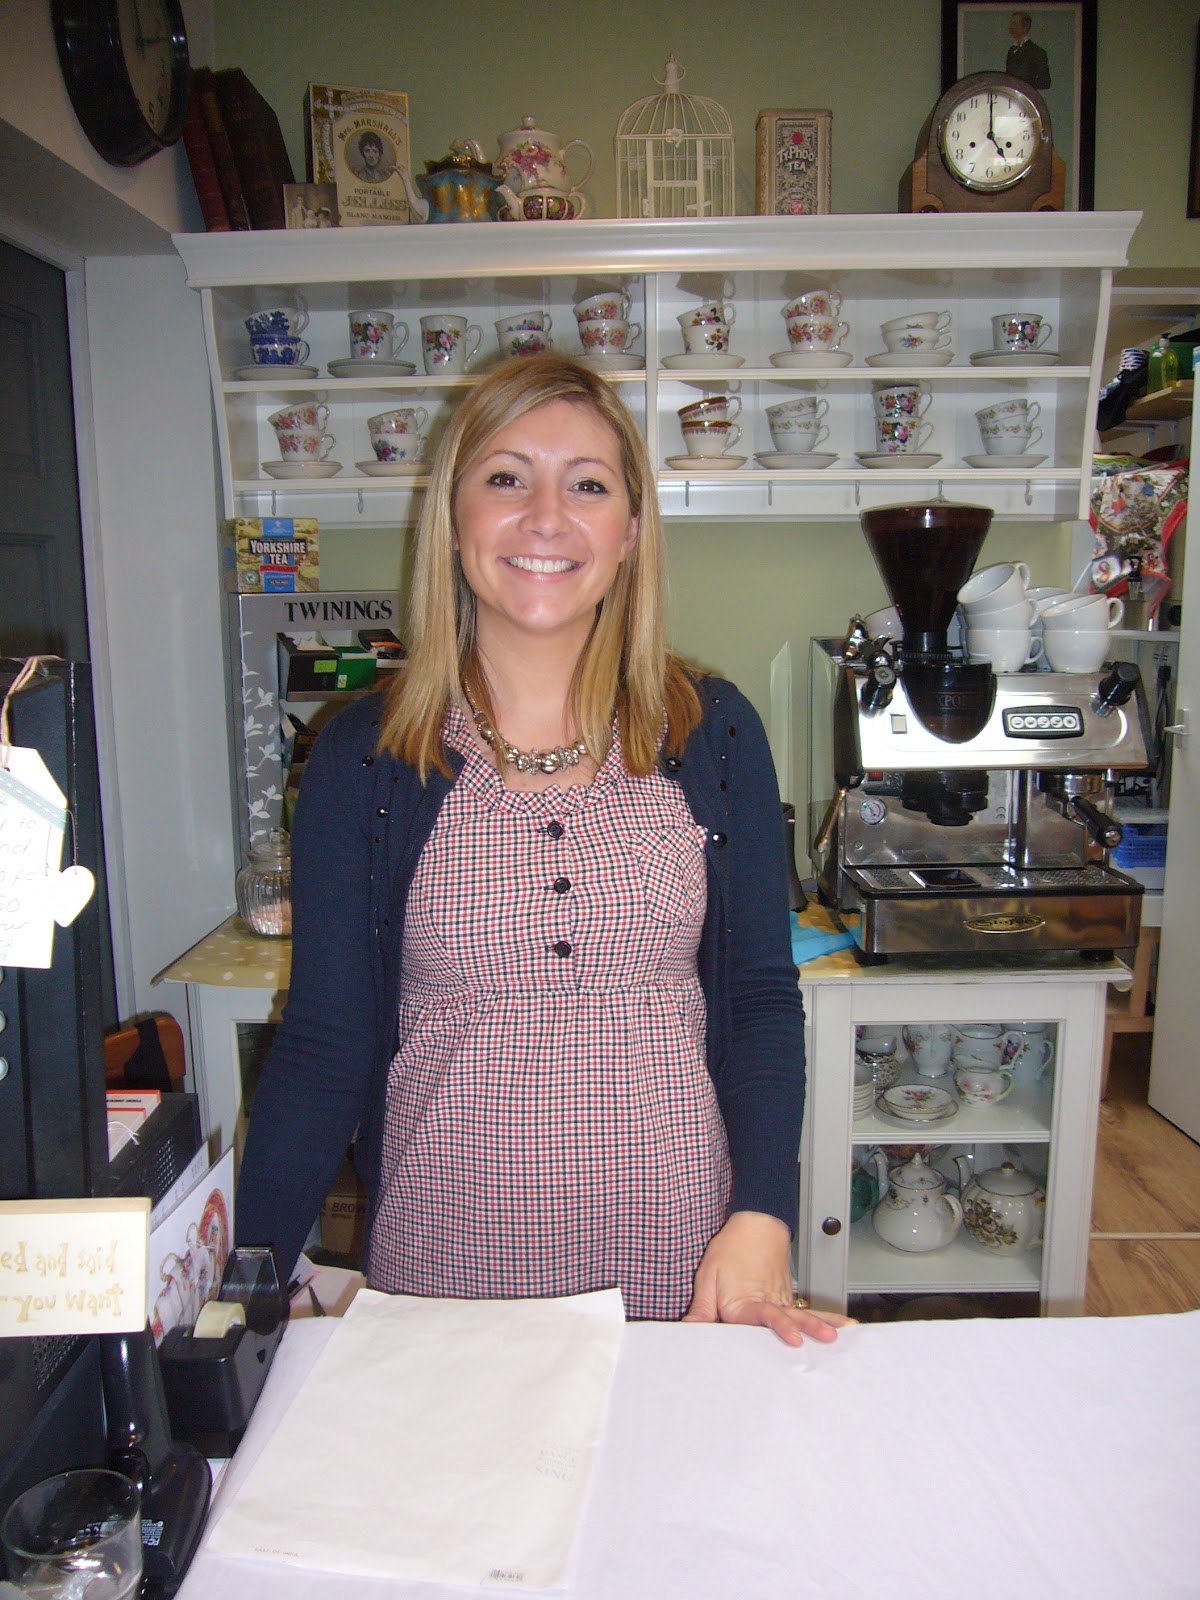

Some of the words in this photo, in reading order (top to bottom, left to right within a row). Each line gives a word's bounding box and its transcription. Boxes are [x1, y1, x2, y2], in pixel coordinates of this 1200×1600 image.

[970, 98, 978, 109] 11
[956, 112, 967, 123] 10
[952, 130, 960, 141] 9
[955, 148, 964, 160] 8
[1016, 148, 1024, 159] 4
[787, 160, 807, 173] TEA
[968, 162, 976, 174] 7
[985, 167, 994, 178] 6
[250, 540, 307, 554] YORKSHIRE
[269, 553, 288, 565] TEA
[284, 600, 393, 622] TWININGS
[35, 1240, 71, 1279] and
[76, 1240, 119, 1276] said
